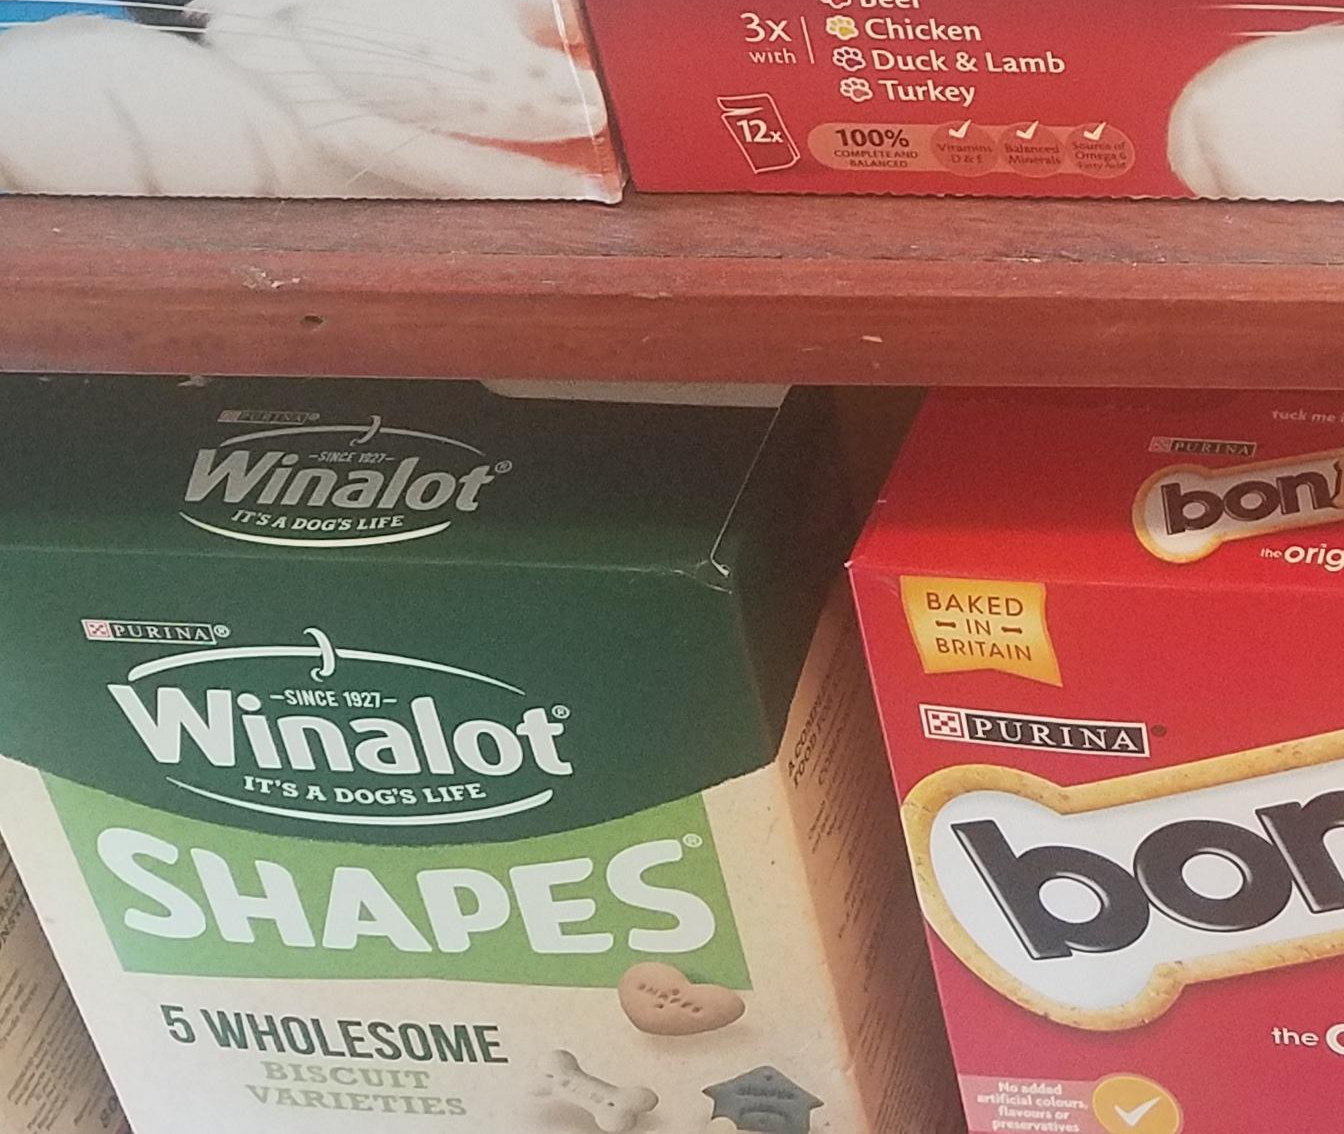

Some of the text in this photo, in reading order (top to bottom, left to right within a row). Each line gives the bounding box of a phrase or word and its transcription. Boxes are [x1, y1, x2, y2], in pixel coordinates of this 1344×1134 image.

[741, 13, 792, 44] 3x
[865, 17, 982, 43] Chicken
[749, 48, 798, 65] with
[873, 48, 1065, 74] Duck & Lamb
[879, 80, 975, 107] Turkey
[737, 119, 783, 145] 12x
[835, 128, 910, 149] 100%
[833, 149, 919, 160] COMPLETE AND
[937, 142, 993, 154] Vitamins
[1004, 143, 1060, 154] Balanced
[849, 159, 909, 168] BALANCED
[1006, 155, 1062, 166] Minerals
[317, 451, 355, 463] SINCE
[1173, 439, 1252, 457] PURINA
[184, 449, 495, 512] Winalot
[231, 509, 405, 531] IT'S A DOG'S LIFE
[1260, 546, 1282, 559] the
[926, 591, 1024, 617] BAKED
[112, 623, 211, 643] PURINA
[964, 618, 993, 636] IN
[935, 637, 1033, 663] BRITAIN
[285, 690, 382, 709] SINCE 1927
[107, 683, 574, 776] Winalot
[972, 717, 1141, 755] PURINA
[243, 775, 487, 805] IT'S A DOG'S LIFE
[96, 827, 717, 955] SHAPES
[160, 1003, 509, 1064] 5 WHOLESOME
[1271, 1025, 1320, 1048] the
[260, 1061, 431, 1090] BISCUIT
[998, 1082, 1062, 1095] No added
[244, 1084, 468, 1117] VARIETIES
[977, 1093, 1089, 1110] artificial colours,
[998, 1106, 1070, 1121] flavours or
[992, 1117, 1080, 1133] preservatives
